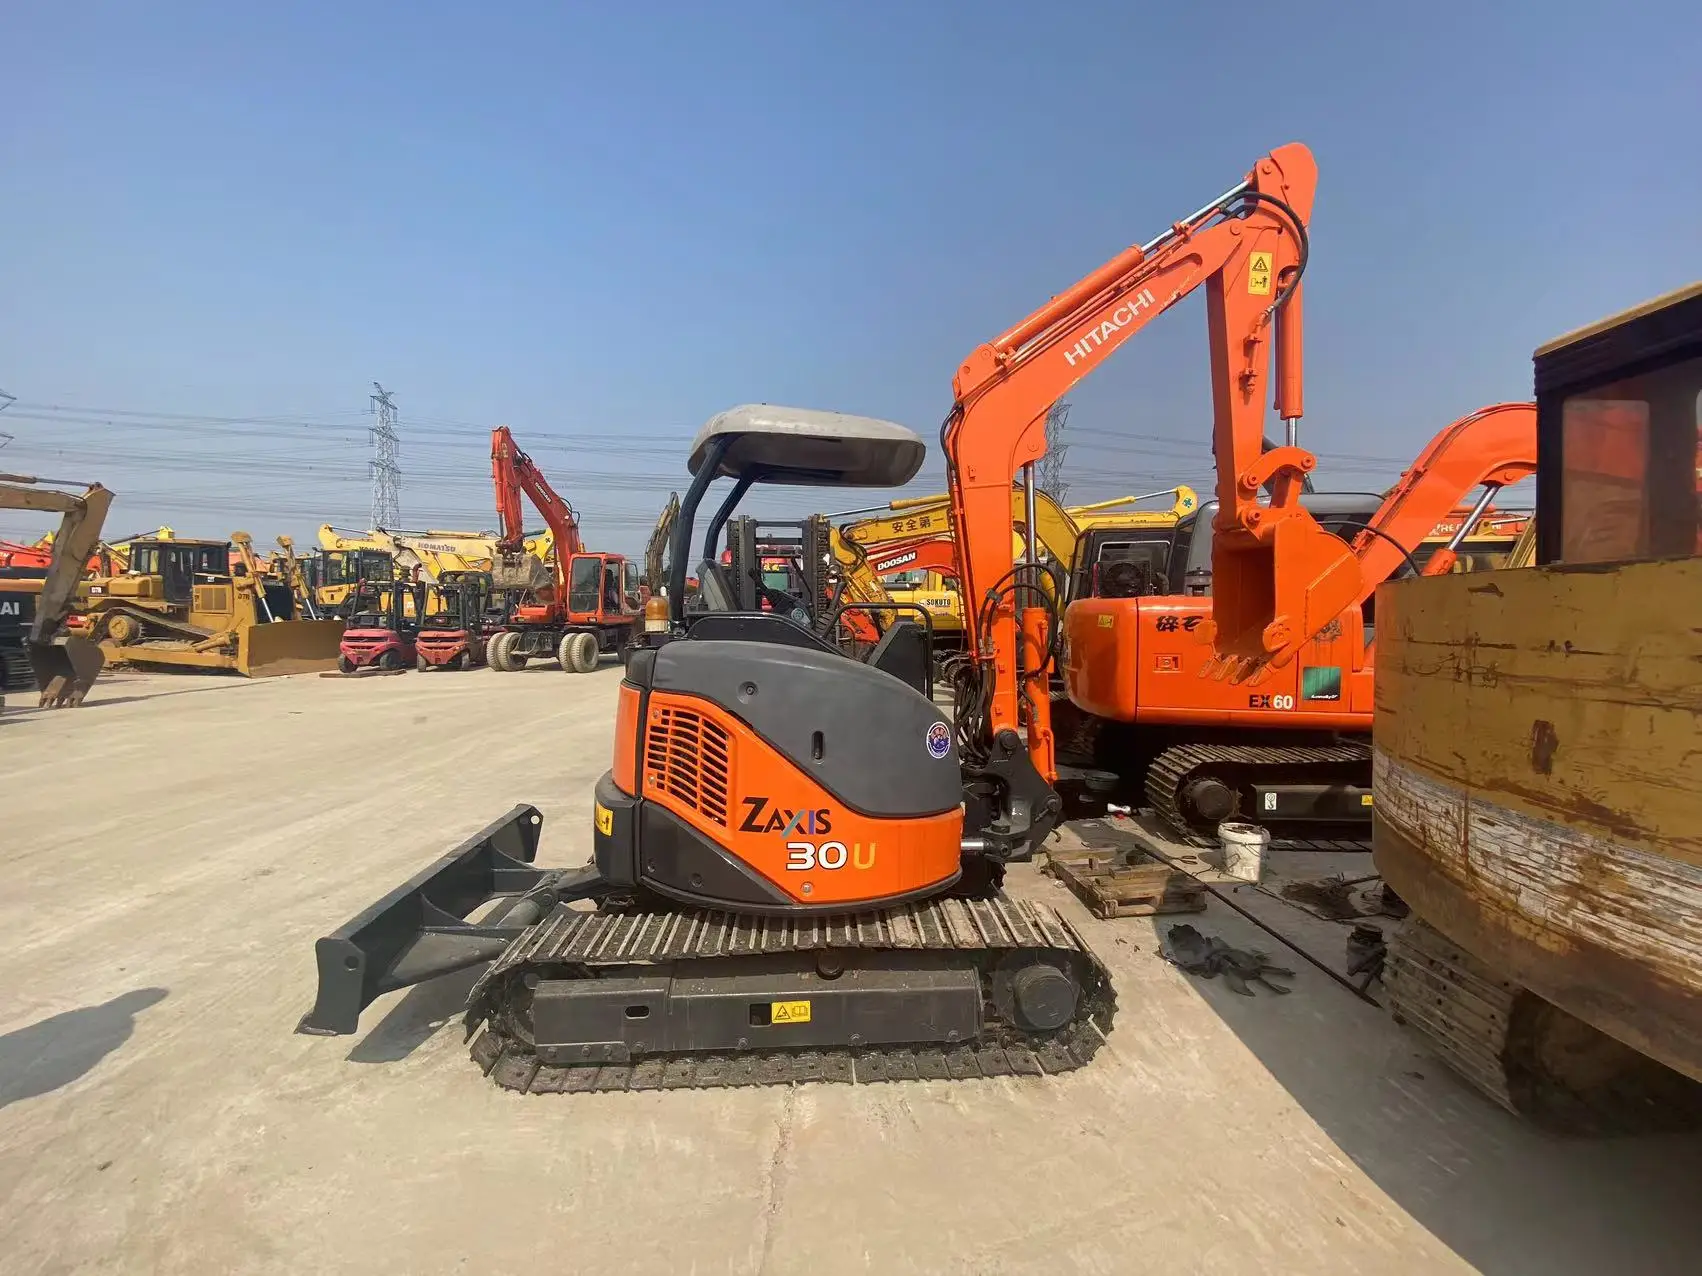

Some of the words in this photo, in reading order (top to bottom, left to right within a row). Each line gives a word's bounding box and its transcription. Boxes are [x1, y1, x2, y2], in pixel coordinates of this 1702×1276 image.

[1063, 288, 1156, 367] HITACHI
[892, 516, 944, 533] 安全第一
[418, 542, 456, 552] KOMATSU
[877, 552, 917, 571] DOOSAN
[926, 598, 951, 606] SOKUTO
